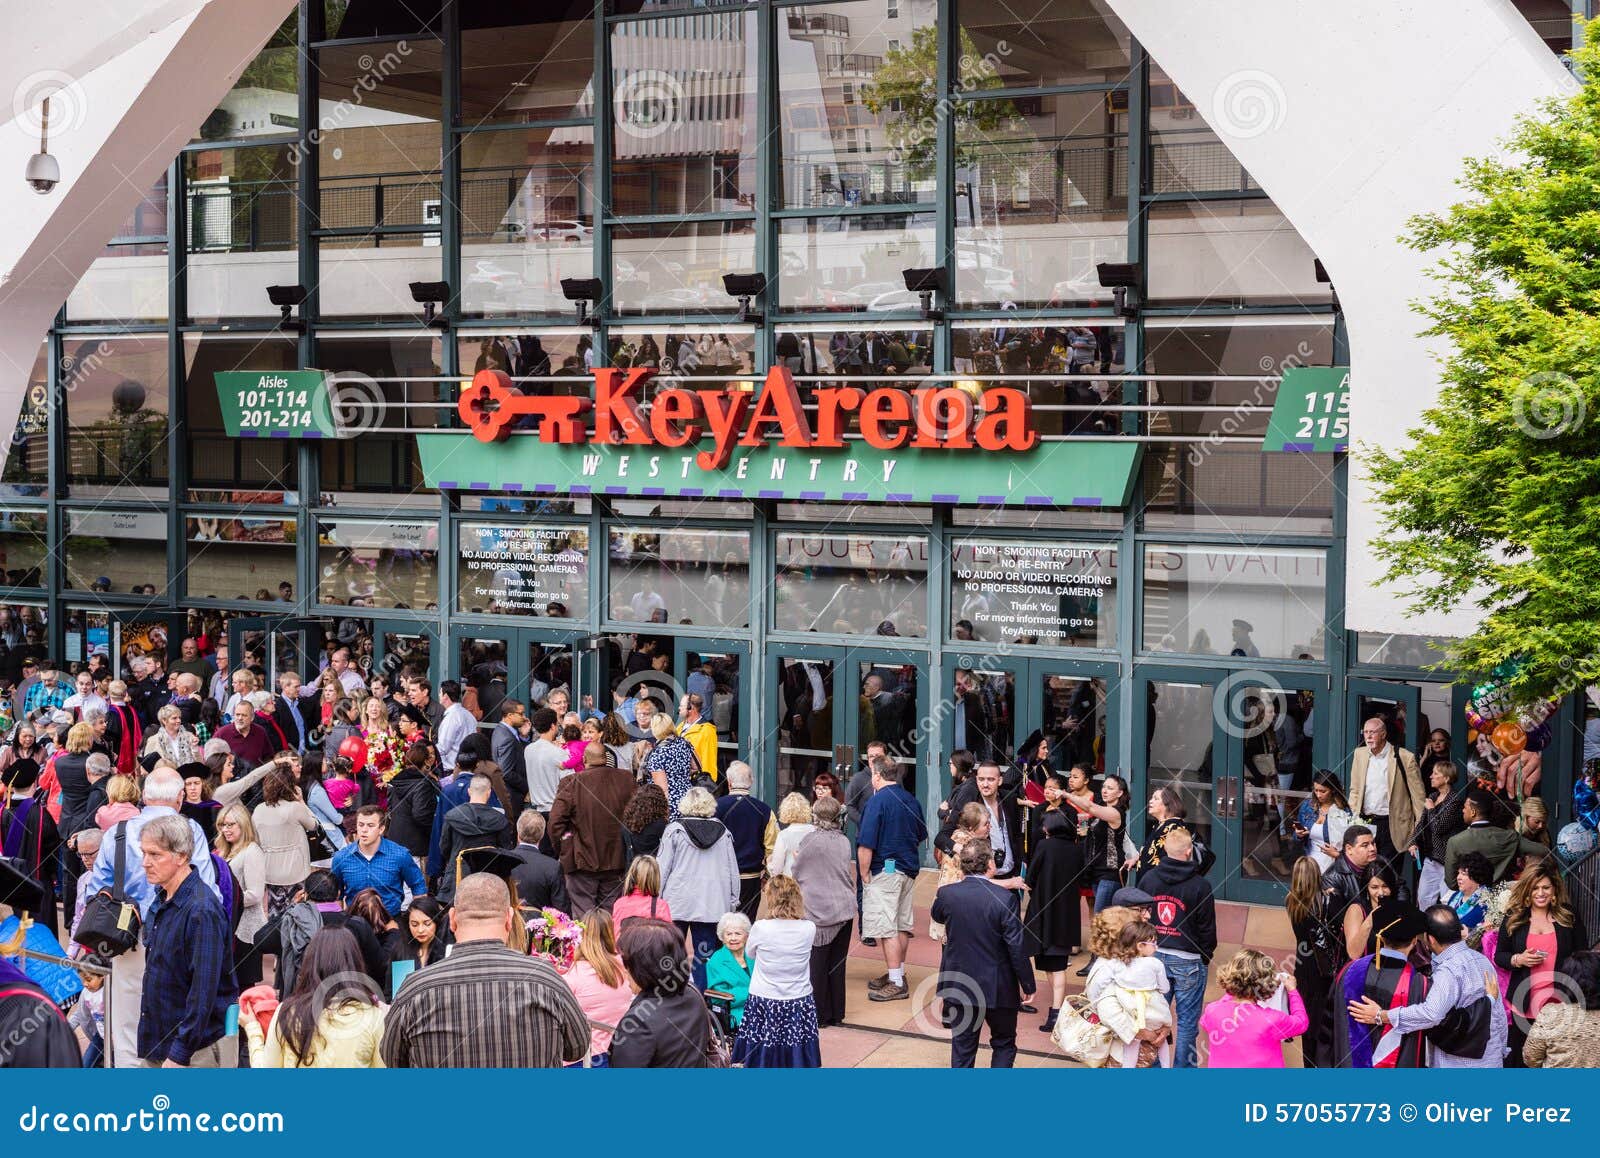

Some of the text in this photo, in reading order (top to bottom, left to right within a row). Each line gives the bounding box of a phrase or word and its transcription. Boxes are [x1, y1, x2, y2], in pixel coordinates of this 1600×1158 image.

[258, 376, 288, 388] Aisles
[237, 390, 308, 408] 101-114
[1305, 391, 1350, 413] 115
[239, 410, 312, 427] 201-214
[589, 364, 1040, 472] KeyArena
[1295, 416, 1349, 438] 215
[582, 454, 898, 482] WEST ENTRY
[475, 529, 493, 537] NON
[499, 529, 535, 539] SMOKING
[536, 530, 570, 540] FACILITY
[496, 541, 548, 550] NO RE-ENTRY
[462, 550, 584, 563] NO AUDIO OR VIDEO RECORDING
[975, 546, 994, 555] NON
[1003, 547, 1050, 557] SMOKING
[1051, 548, 1094, 559] FACILITY
[468, 561, 578, 574] NO PROFESSIONAL CAMERAS
[1001, 559, 1067, 570] NO RE-ENTRY
[504, 578, 540, 587] Thank You
[957, 570, 1112, 585] NO AUDIO OR VIDEO RECORDING
[475, 587, 488, 595] For
[508, 589, 549, 599] information
[550, 592, 560, 600] go
[561, 591, 569, 600] to
[965, 583, 1104, 597] NO PROFESSIONAL CAMERAS
[496, 600, 548, 610] KeyArena.com
[1010, 601, 1057, 612] Thank You
[975, 612, 1094, 627] For more information go to
[1001, 626, 1067, 638] KeyArena.com
